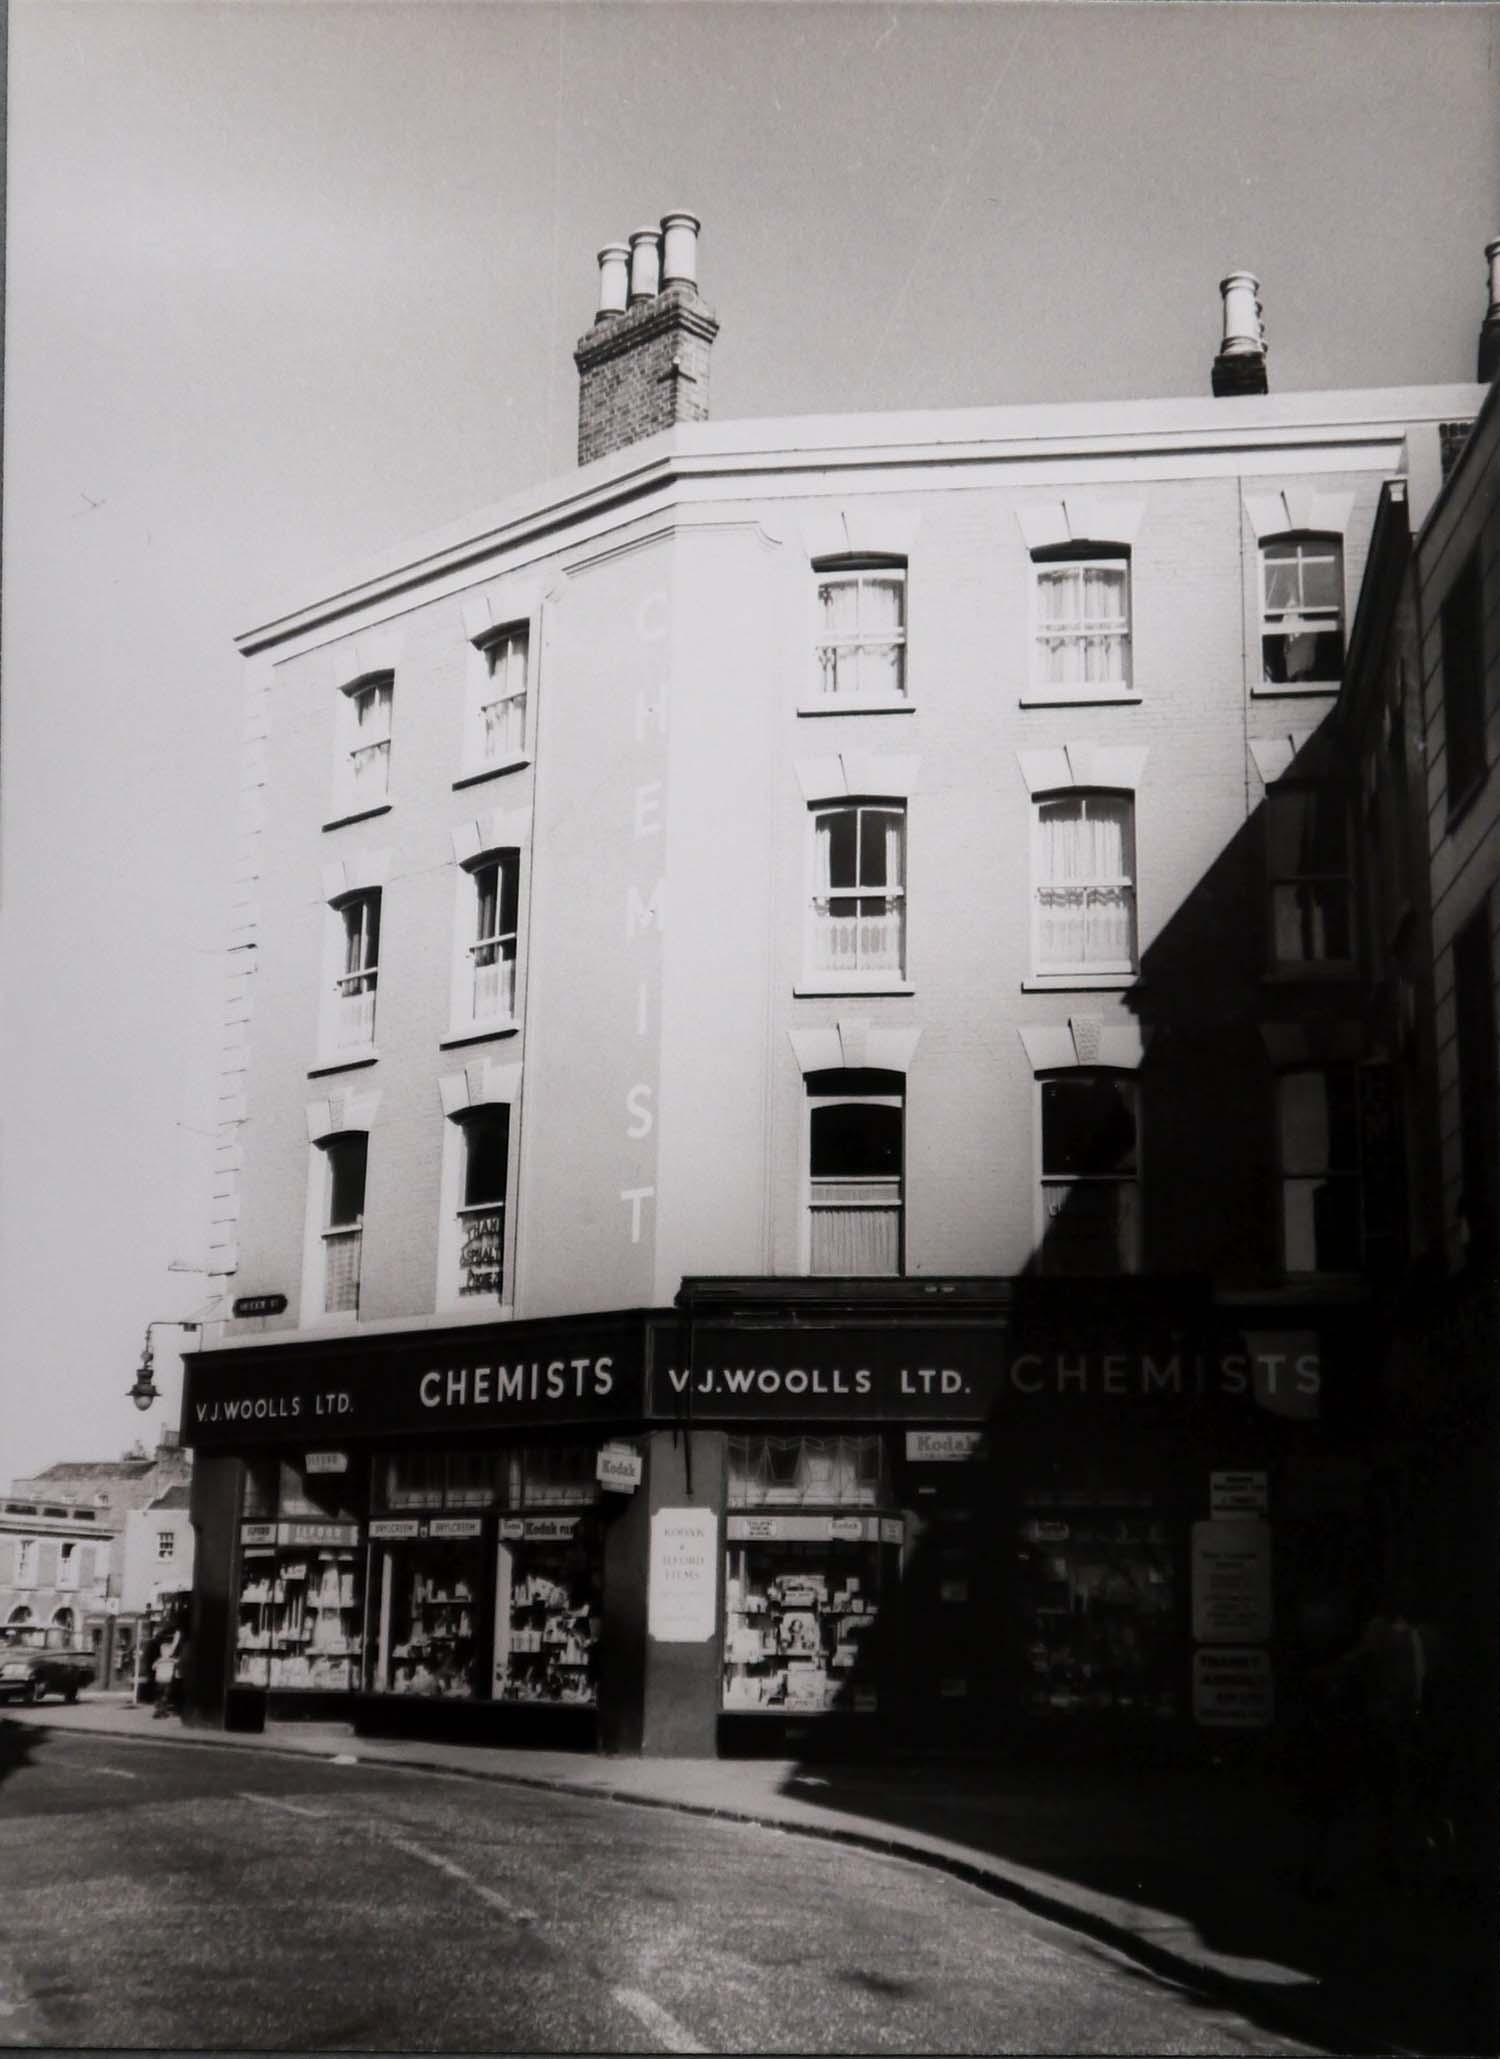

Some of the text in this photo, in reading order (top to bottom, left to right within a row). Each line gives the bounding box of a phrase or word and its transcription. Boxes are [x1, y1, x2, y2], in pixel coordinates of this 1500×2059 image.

[620, 592, 667, 1243] CHEMIST
[419, 1357, 614, 1408] CHEMISTS
[900, 1369, 972, 1395] LTD.
[1009, 1352, 1322, 1395] CHEMISTS
[316, 1393, 353, 1414] LTD.
[602, 1459, 637, 1478] Kodak
[526, 1522, 557, 1536] Kodak
